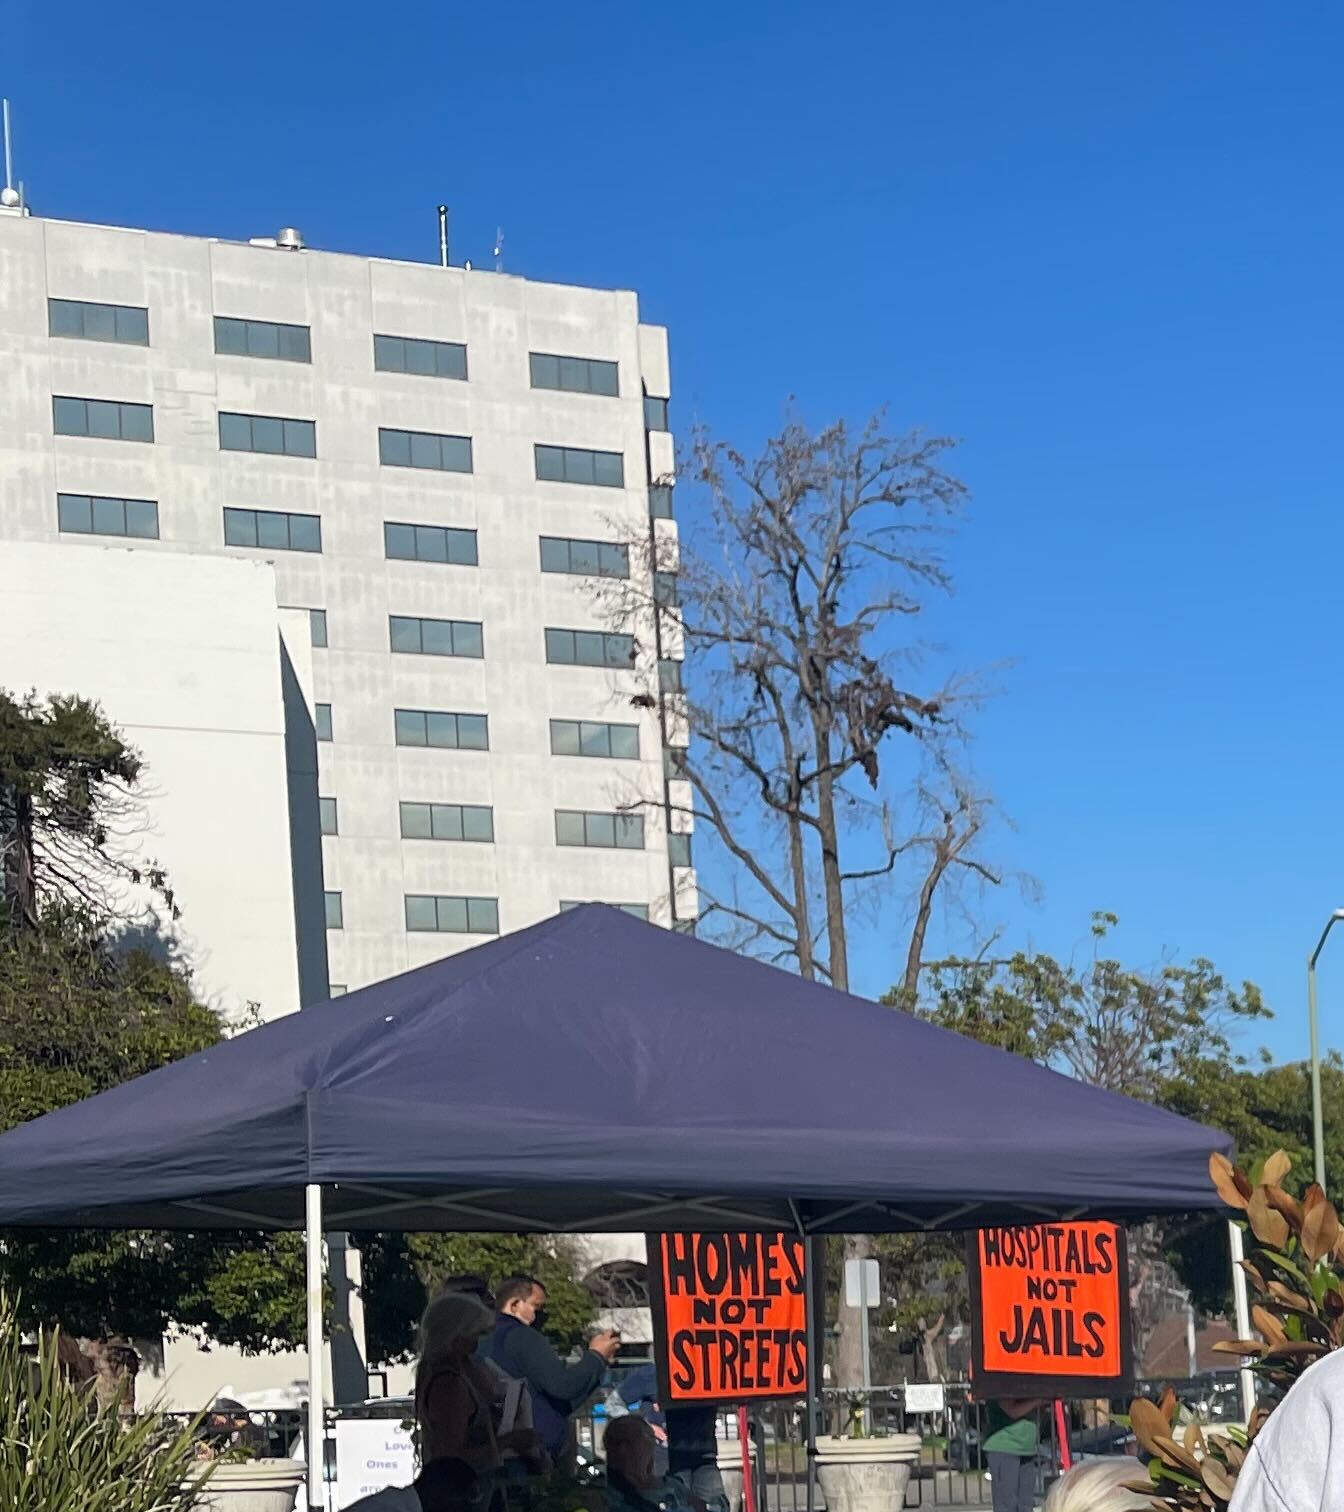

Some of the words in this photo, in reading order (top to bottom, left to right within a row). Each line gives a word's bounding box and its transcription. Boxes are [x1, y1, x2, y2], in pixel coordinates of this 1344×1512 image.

[666, 1232, 806, 1297] HOMES
[984, 1226, 1113, 1275] HOSPITALS
[693, 1298, 772, 1325] NOT
[1027, 1275, 1078, 1303] NOT
[999, 1305, 1106, 1358] JAILS
[672, 1329, 806, 1391] STREETS
